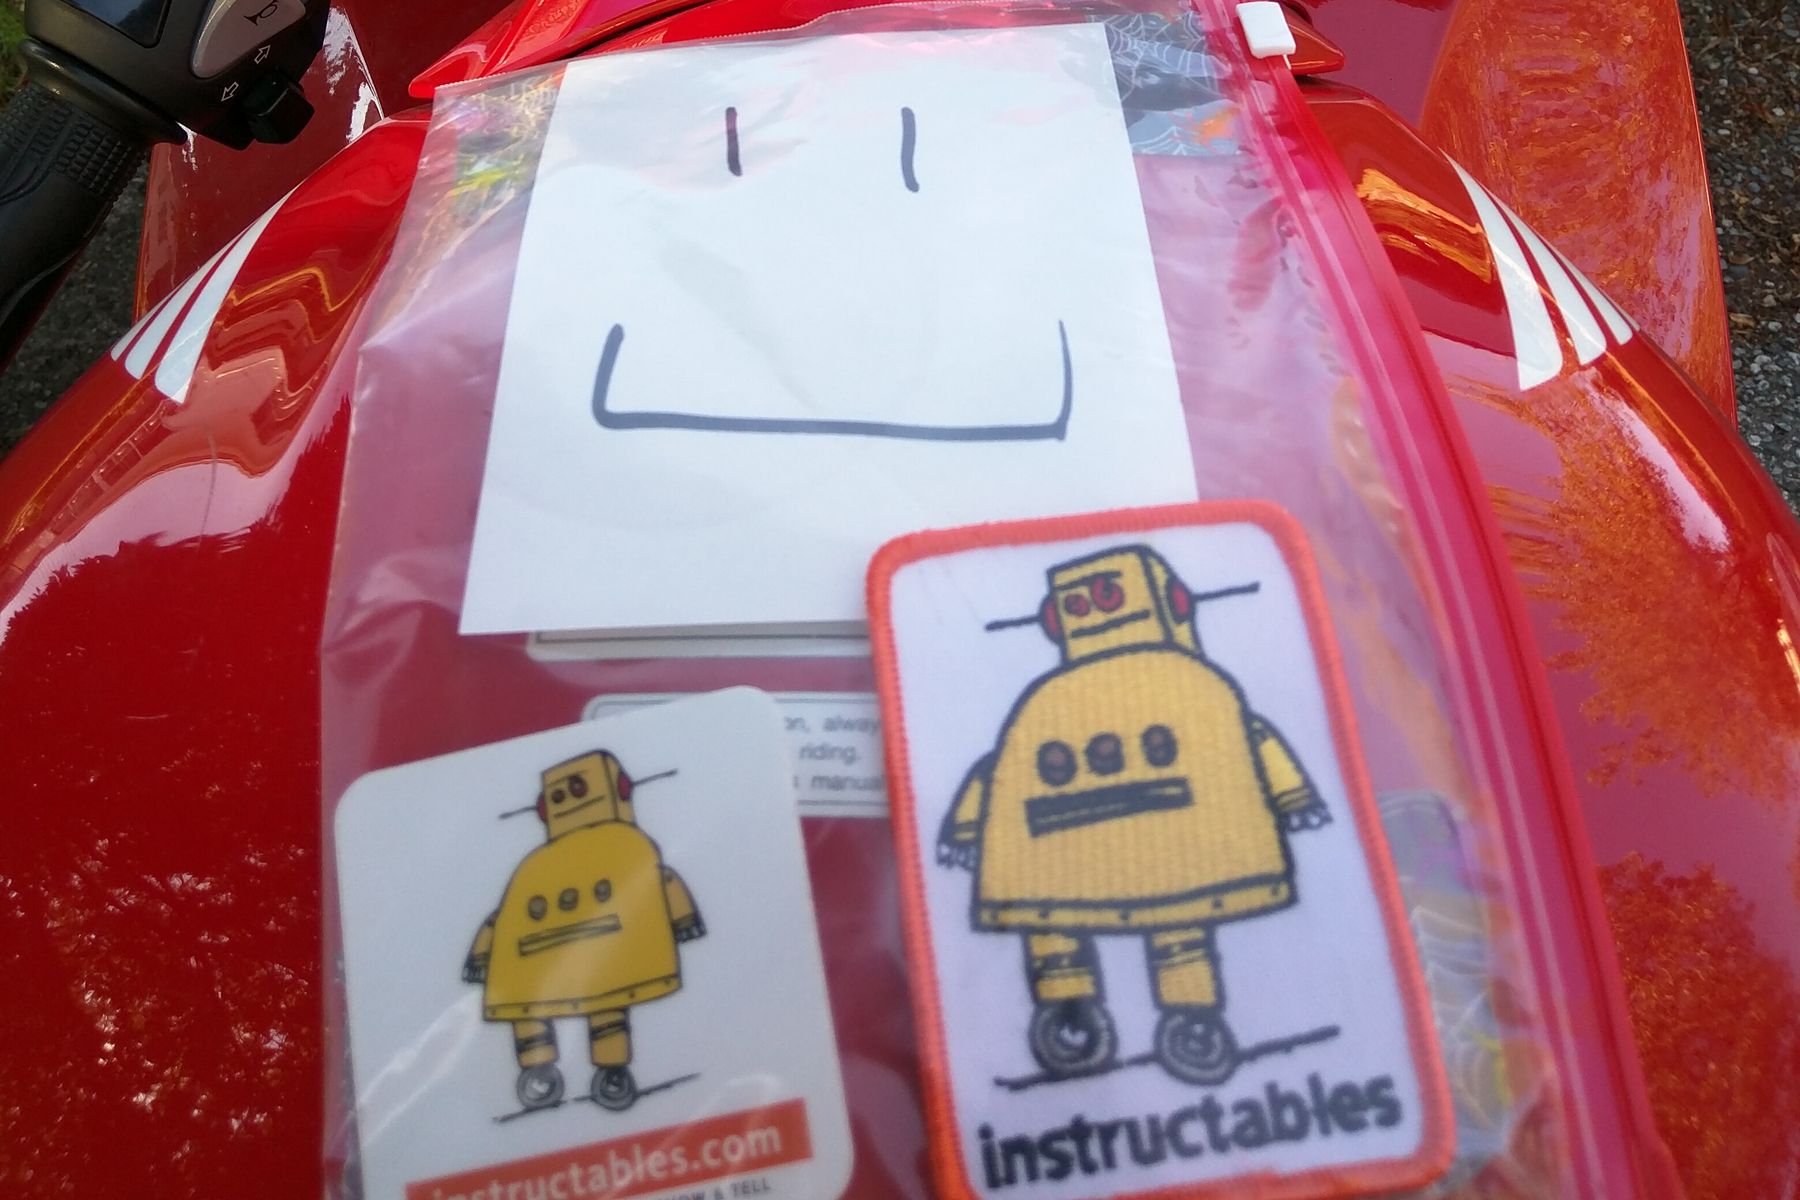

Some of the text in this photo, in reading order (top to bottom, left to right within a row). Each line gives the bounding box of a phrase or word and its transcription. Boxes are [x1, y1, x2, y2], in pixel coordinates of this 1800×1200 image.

[433, 1125, 783, 1200] tructables.com
[977, 1071, 1403, 1189] instructables
[729, 1177, 772, 1199] TELL
